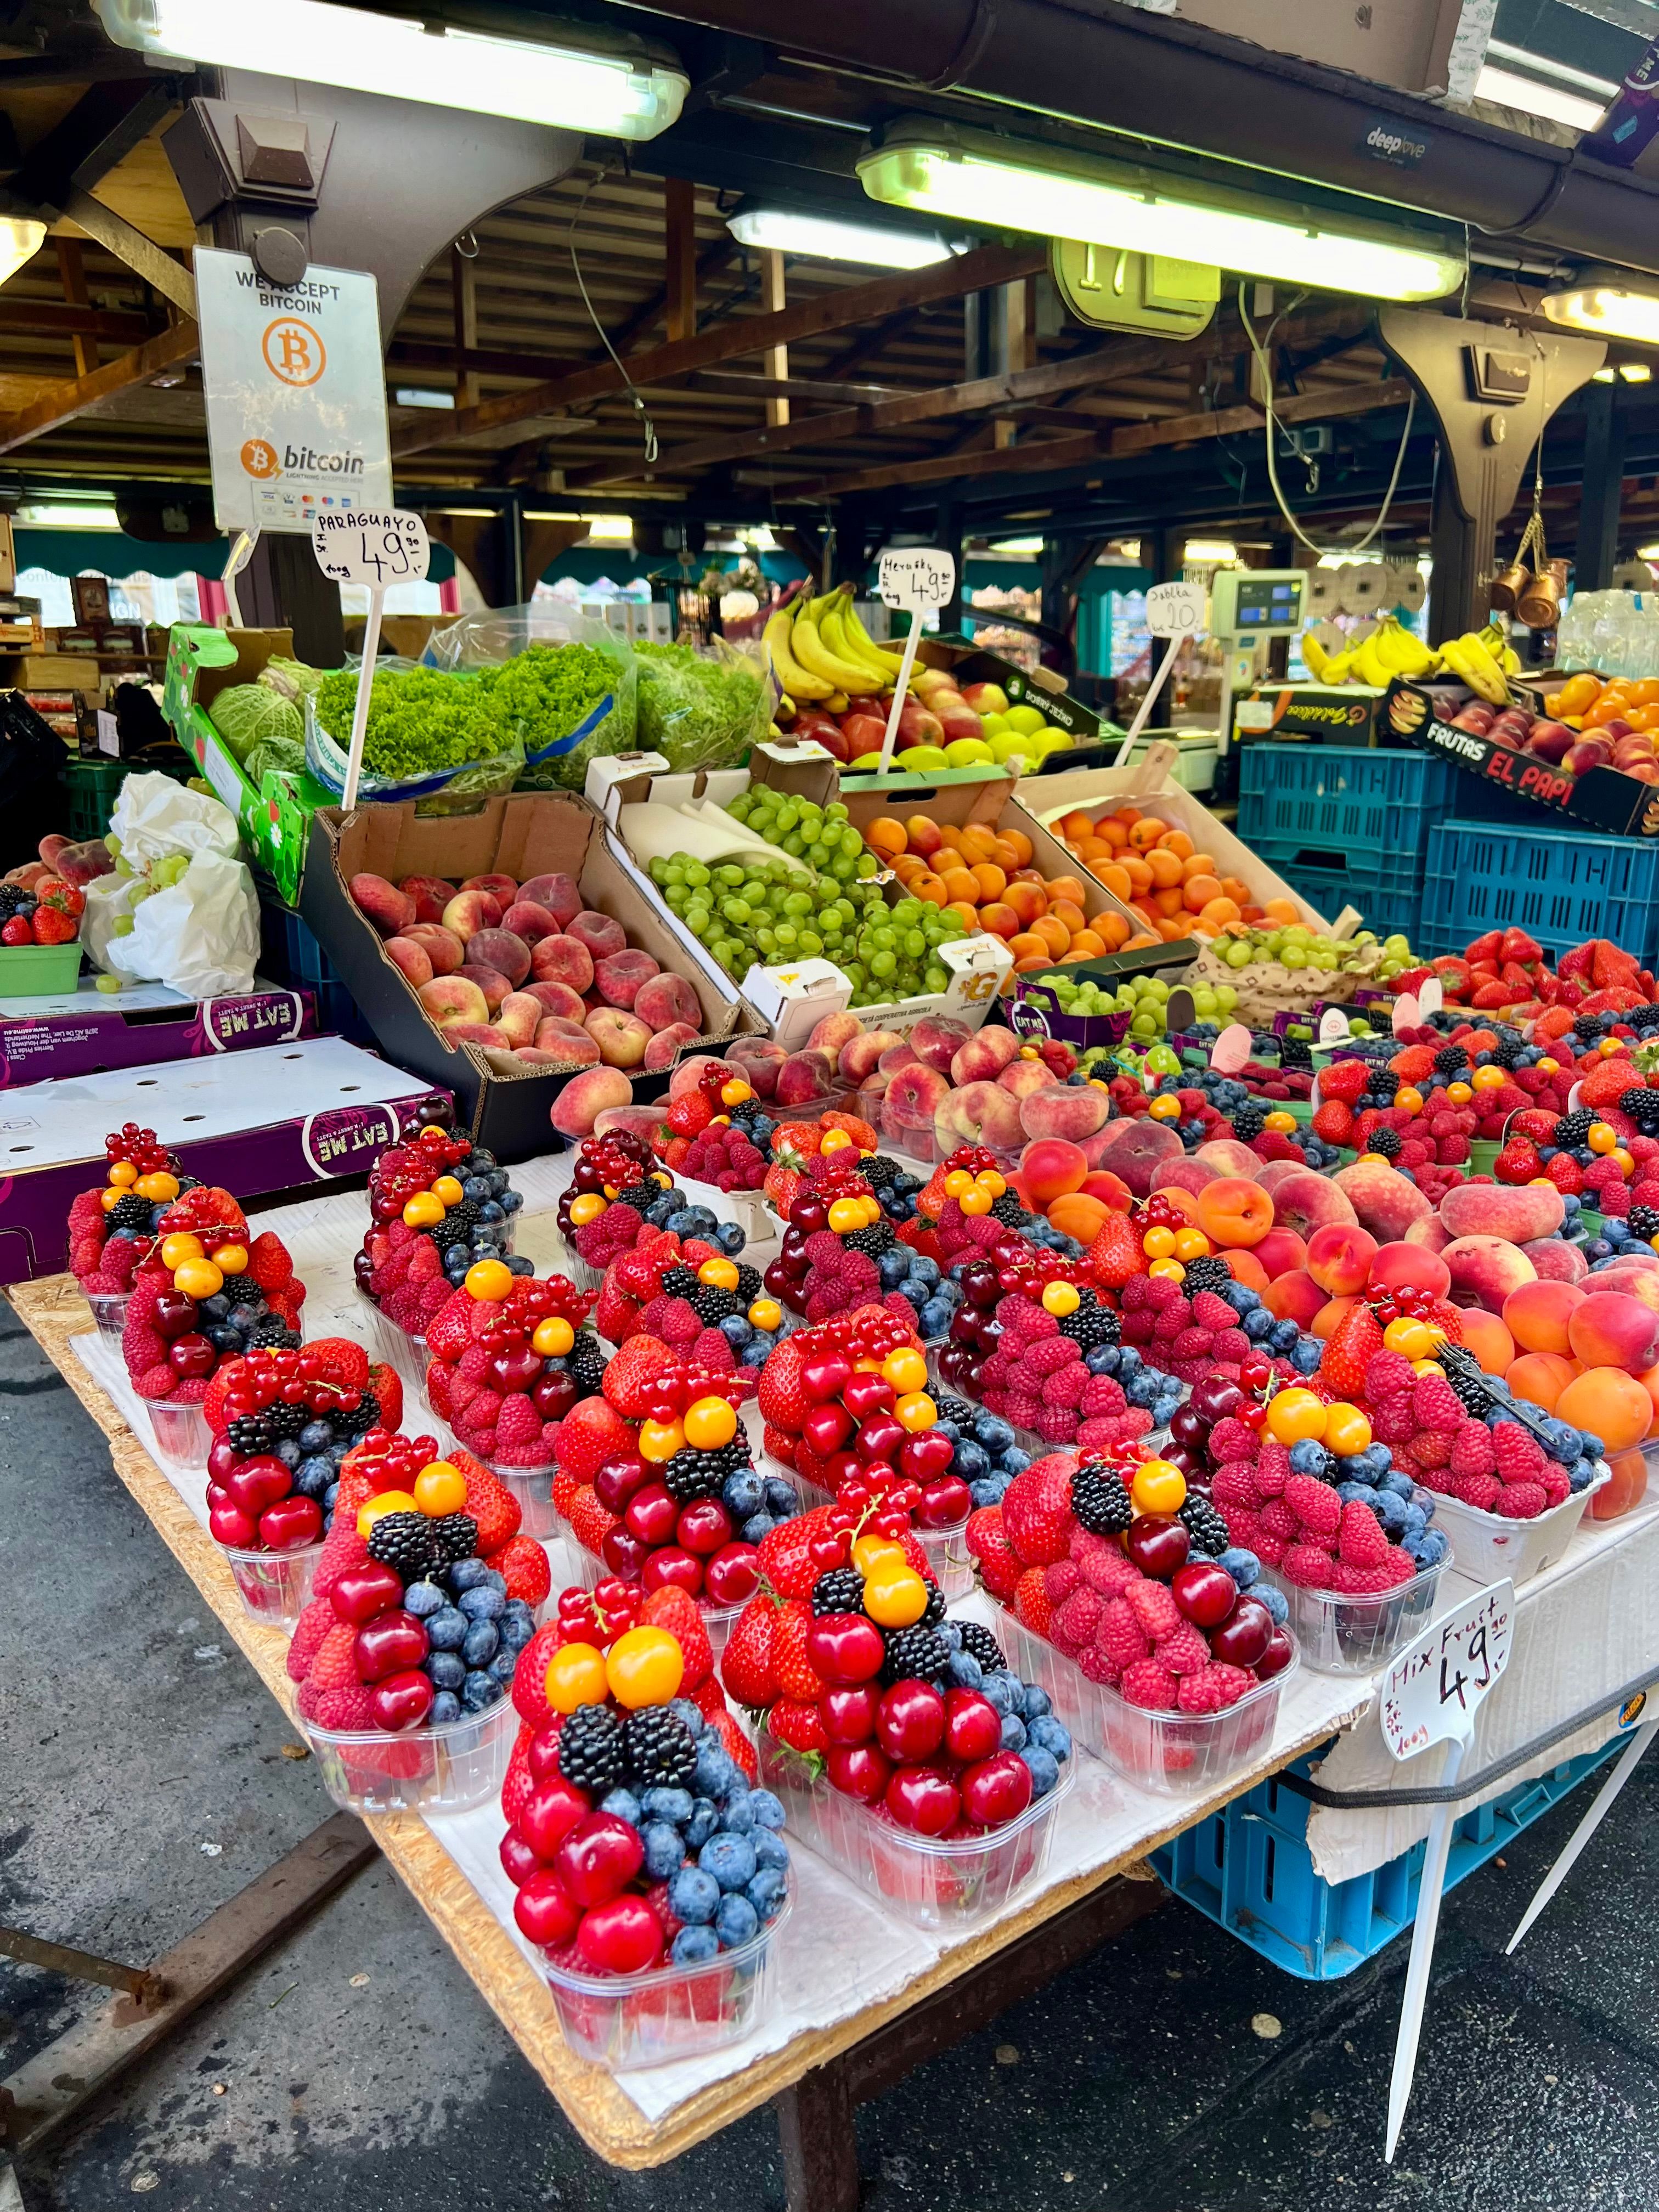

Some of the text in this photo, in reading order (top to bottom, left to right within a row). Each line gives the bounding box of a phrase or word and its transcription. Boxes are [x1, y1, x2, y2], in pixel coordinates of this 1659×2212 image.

[235, 271, 340, 301] WE CEPT
[259, 293, 321, 314] BITCOIN
[284, 445, 364, 475] bitcoin
[318, 514, 416, 531] PARAGUAYO
[362, 532, 409, 583] 49
[912, 573, 939, 602] 49
[1427, 722, 1575, 806] FRUTAS EL PAPI
[219, 1003, 291, 1038] EAT ME
[874, 1011, 907, 1022] COOPERATIVA
[908, 1006, 932, 1015] AGRICOLA
[1016, 1015, 1043, 1029] EAT ME
[4, 1026, 49, 1035] www.eatme.eu
[4, 1034, 40, 1042] Netherlands
[317, 1132, 332, 1142] TASTY
[318, 1122, 388, 1162] EAT ME
[338, 1125, 354, 1135] SWEET
[1392, 1596, 1499, 1692] Mix Fruit
[1440, 1626, 1490, 1710] 49
[1396, 1724, 1429, 1756] 100g
